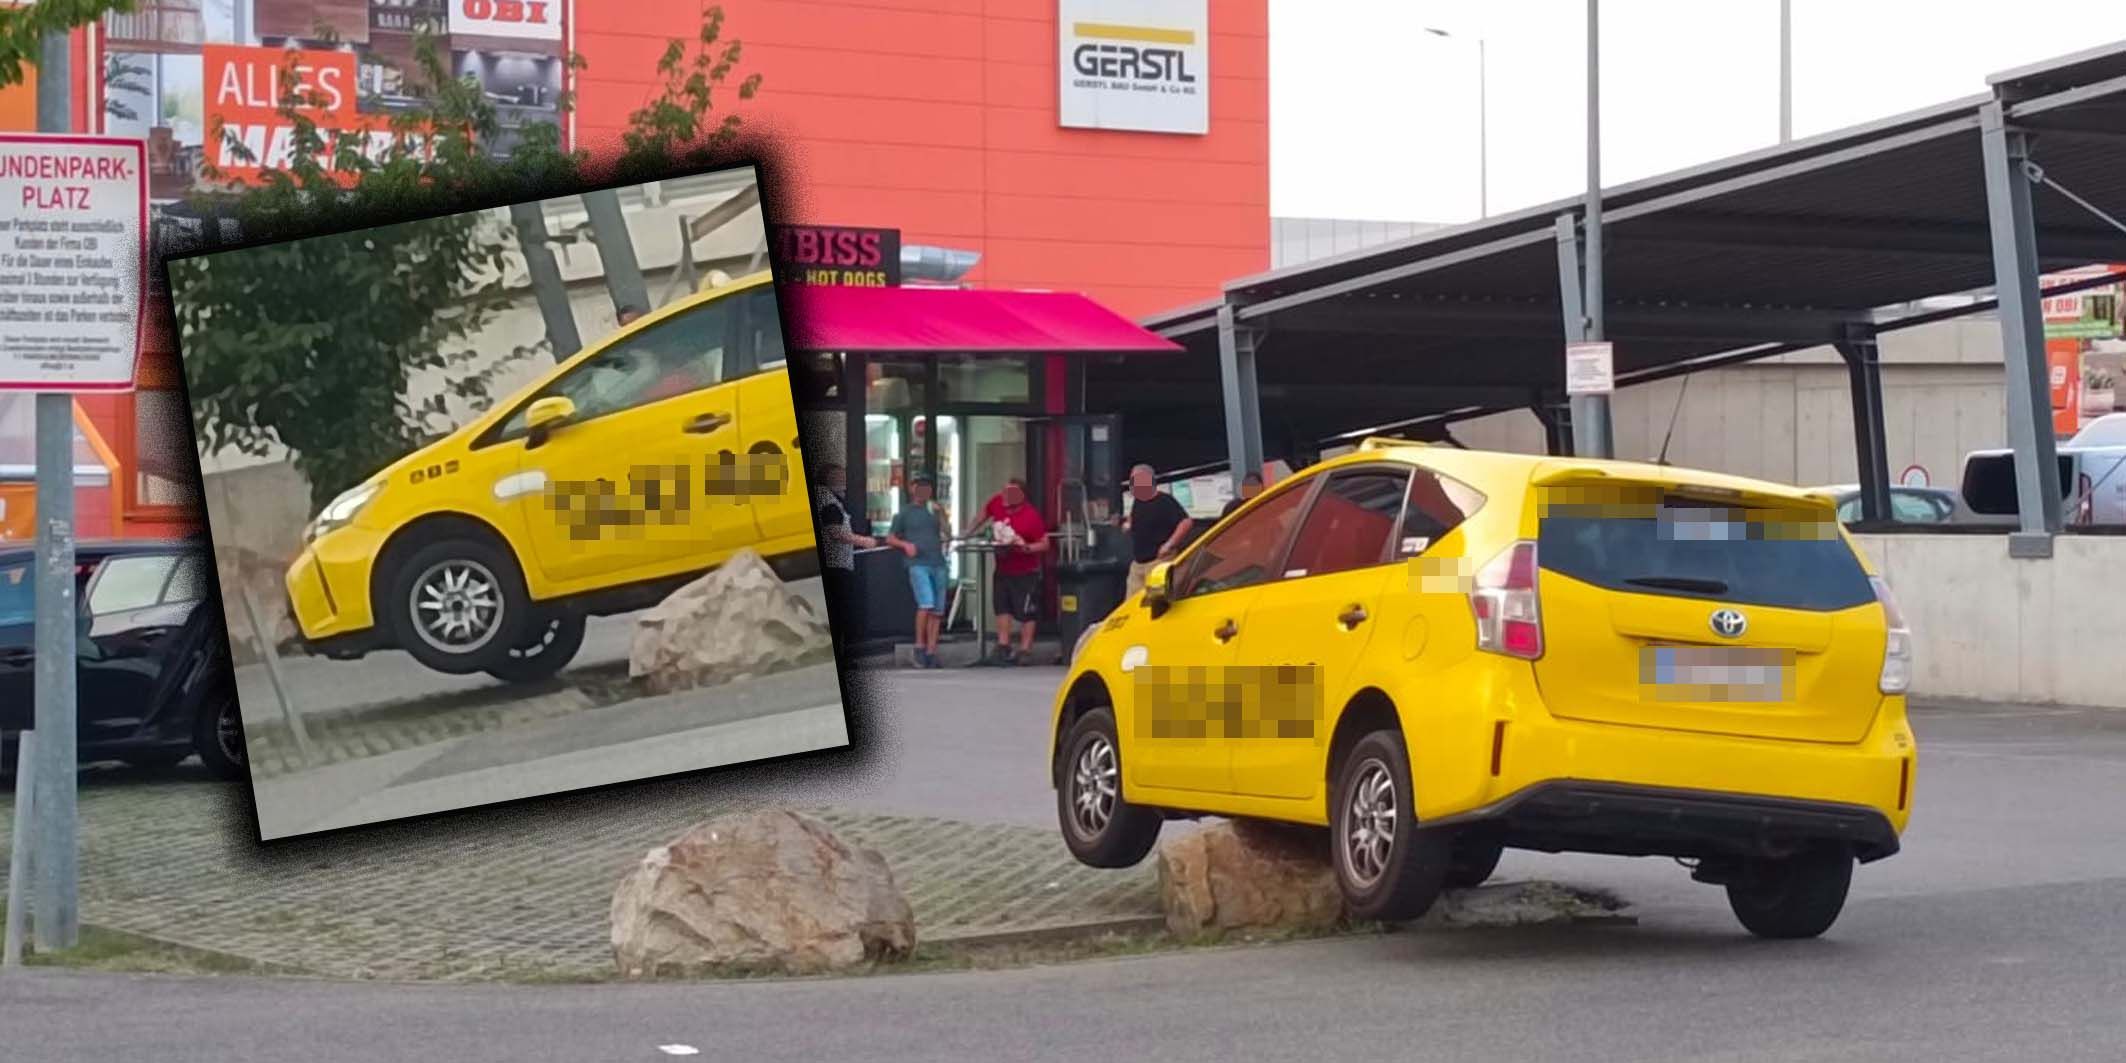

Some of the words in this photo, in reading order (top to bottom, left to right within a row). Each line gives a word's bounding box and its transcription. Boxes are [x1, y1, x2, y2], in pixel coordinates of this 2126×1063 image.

[463, 0, 547, 23] OBI
[1073, 44, 1195, 82] GERSTL
[217, 62, 342, 111] ALLES
[22, 186, 90, 209] PLATZ
[785, 229, 881, 266] BISS
[807, 270, 838, 286] HOT
[843, 270, 887, 288] DOGS
